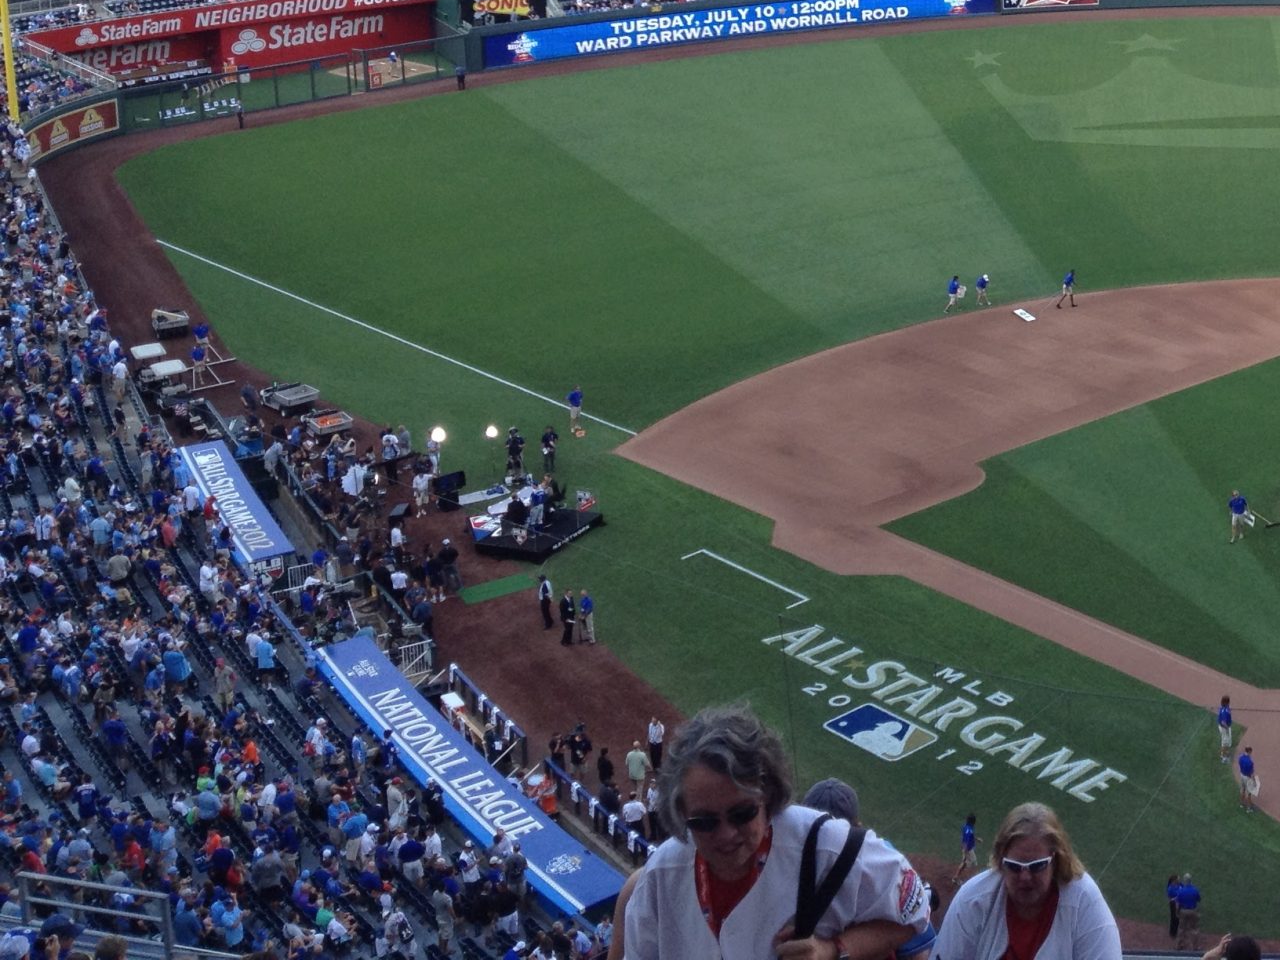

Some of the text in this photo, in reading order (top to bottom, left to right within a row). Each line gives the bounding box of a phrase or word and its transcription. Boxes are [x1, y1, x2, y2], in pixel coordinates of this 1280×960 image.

[576, 6, 909, 54] WARD PARKWAY AND WORNALL ROAD
[611, 12, 700, 35] TUESDAY,
[704, 8, 750, 24] JULY
[754, 5, 775, 18] 10
[250, 557, 282, 572] MLB
[933, 666, 1016, 707] MLB
[368, 687, 544, 841] NATIONAL LEAGUE
[959, 715, 1128, 804] GAME
